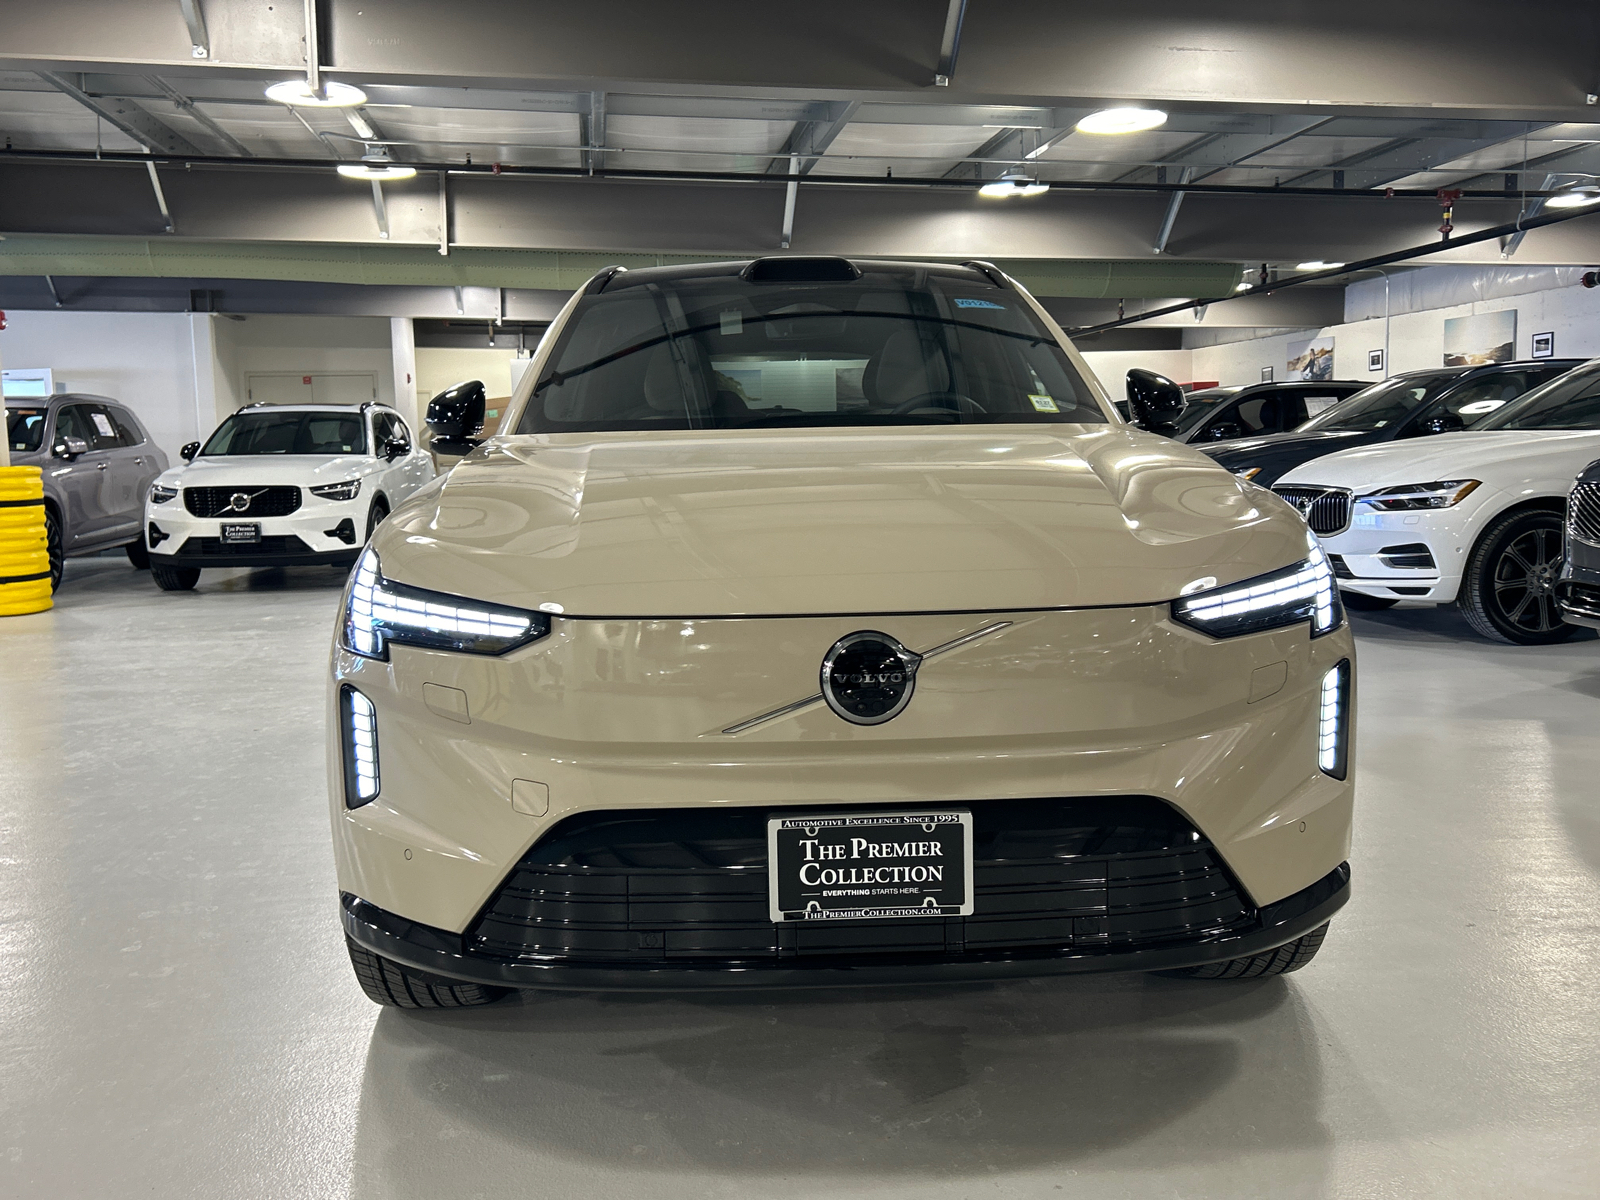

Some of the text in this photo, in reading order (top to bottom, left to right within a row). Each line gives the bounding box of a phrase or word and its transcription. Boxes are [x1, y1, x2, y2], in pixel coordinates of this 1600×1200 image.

[834, 673, 903, 684] VOLVO
[783, 819, 844, 828] AUTOMOTIVE
[845, 817, 902, 825] EXCELLENCE
[903, 816, 931, 824] SINCE
[798, 838, 944, 861] THE PREMIER
[798, 863, 944, 886] COLLECTION
[822, 888, 870, 897] EVERYTHING
[871, 887, 899, 895] STARTS
